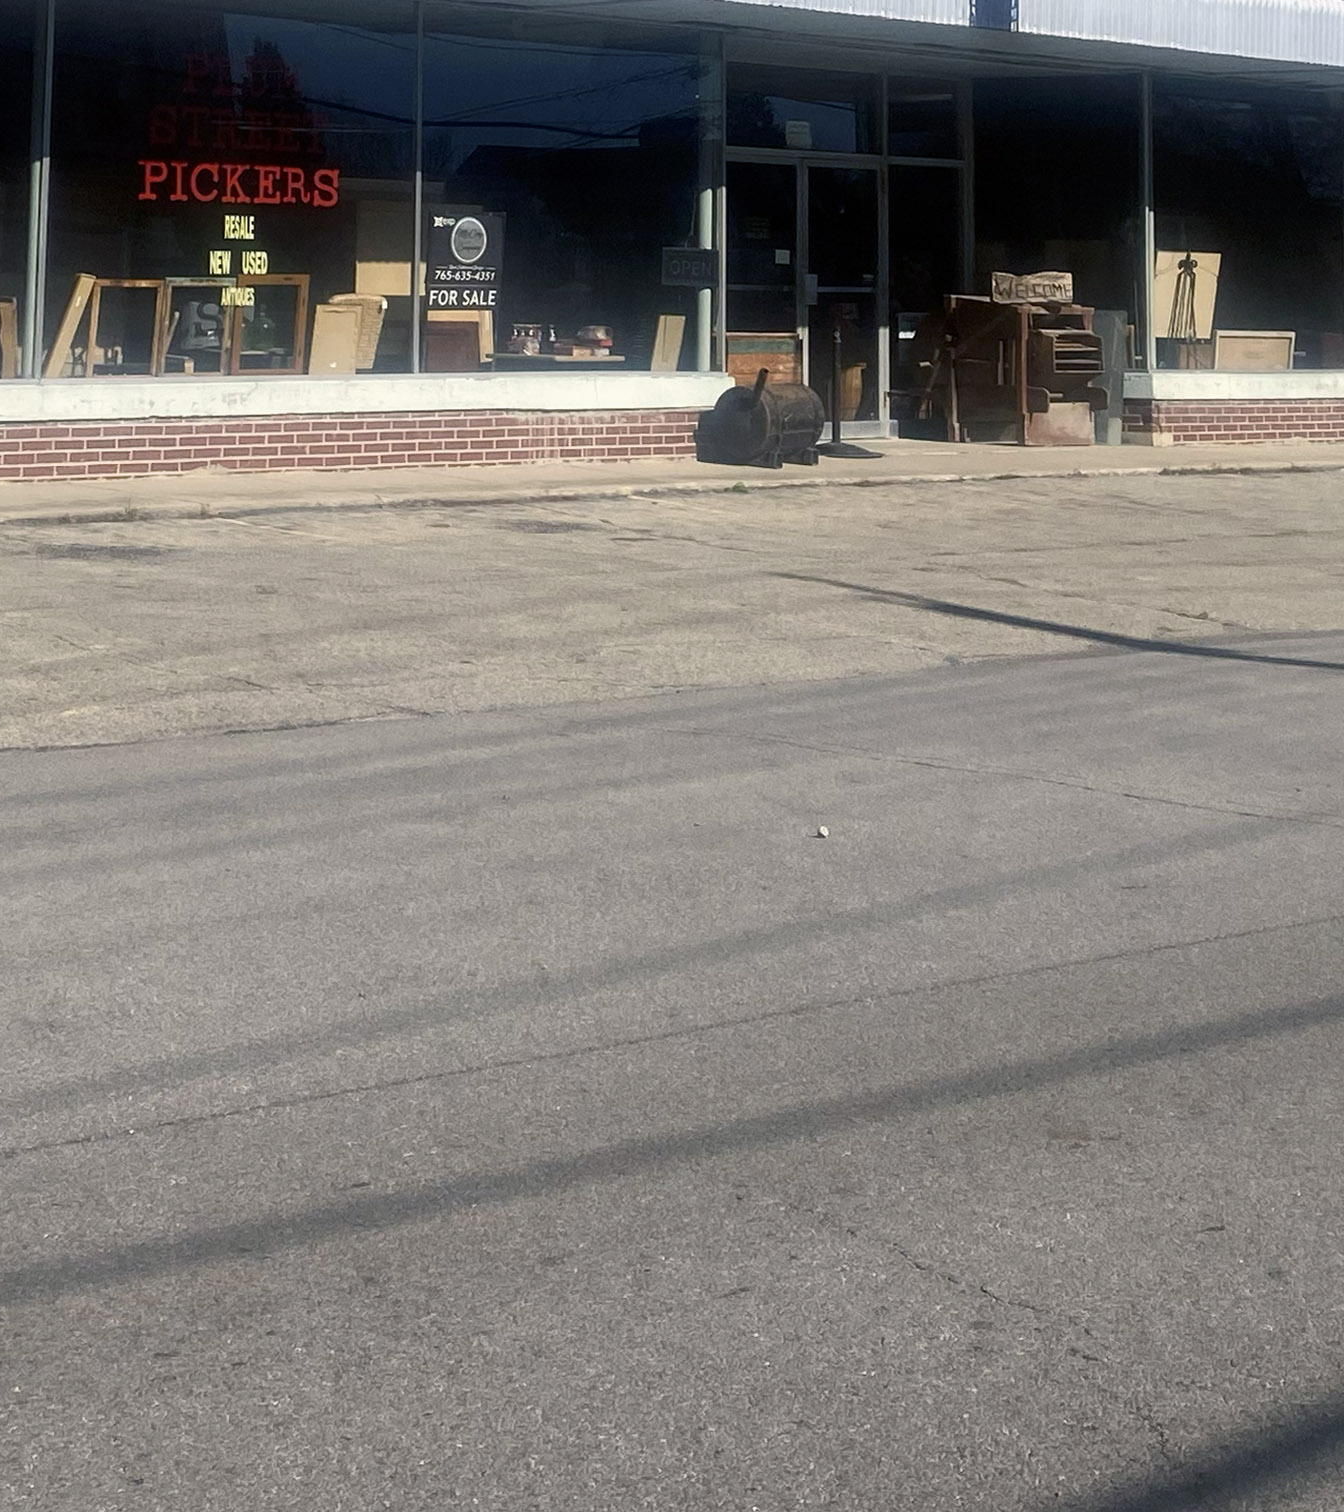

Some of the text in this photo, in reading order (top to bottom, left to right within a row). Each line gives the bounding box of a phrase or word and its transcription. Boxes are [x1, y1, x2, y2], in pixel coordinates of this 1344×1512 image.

[148, 104, 331, 155] STREET
[137, 160, 340, 207] PICKERS
[224, 215, 255, 239] RESALE
[209, 250, 268, 275] NEW USED
[670, 259, 712, 276] OPEN
[220, 287, 255, 306] ANTIQUES
[429, 290, 497, 306] FOR SALE
[994, 277, 1072, 300] WELCOME
